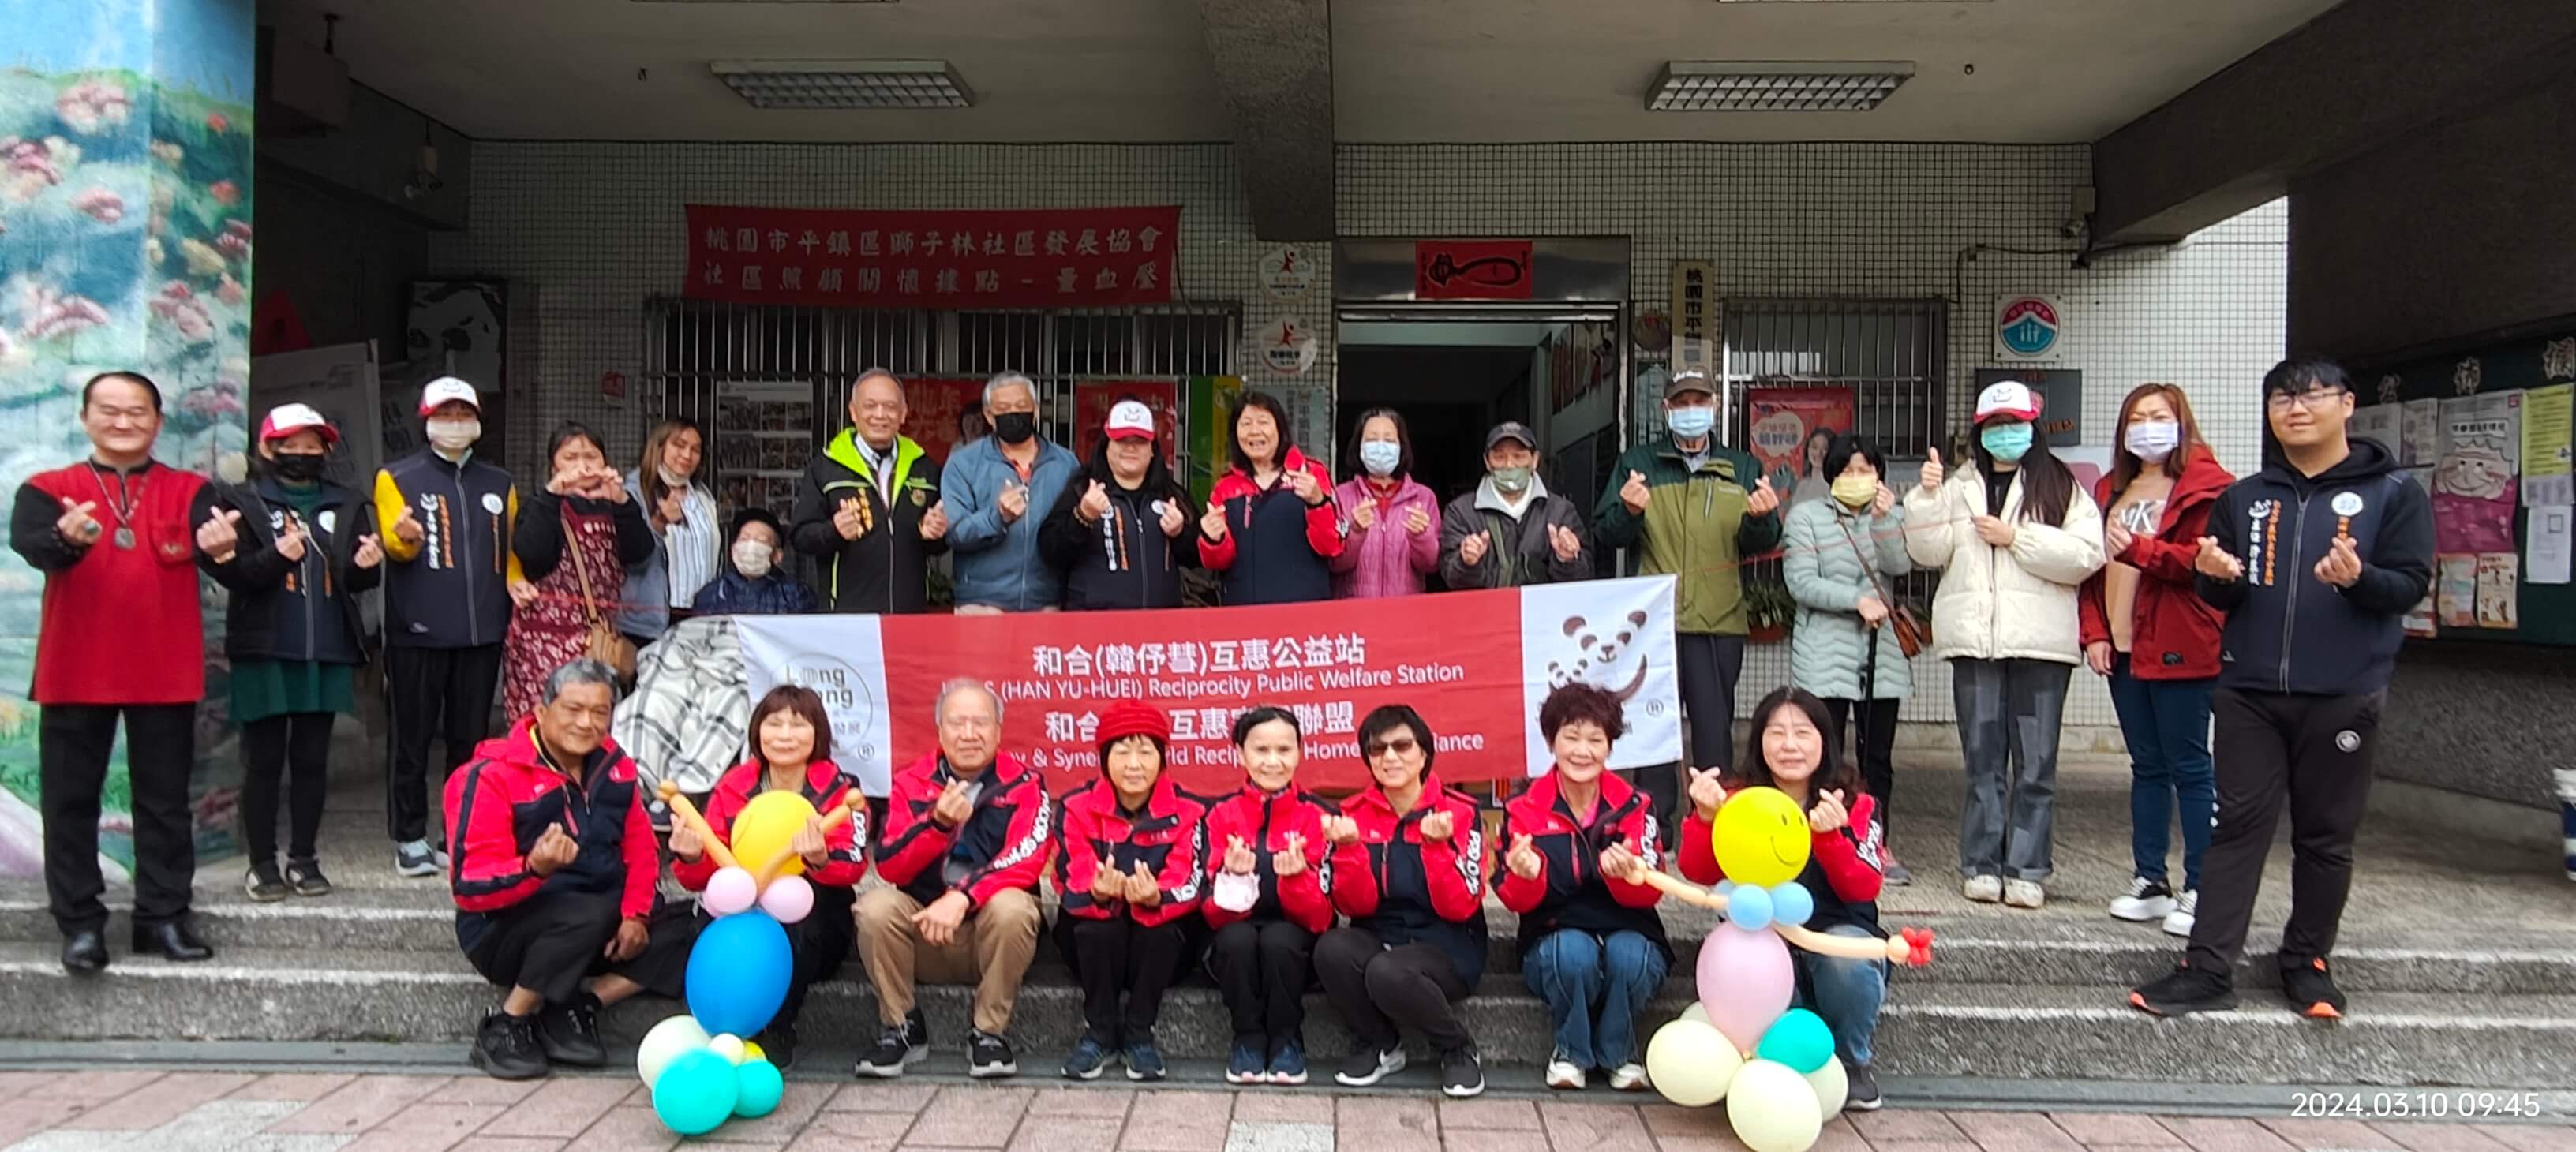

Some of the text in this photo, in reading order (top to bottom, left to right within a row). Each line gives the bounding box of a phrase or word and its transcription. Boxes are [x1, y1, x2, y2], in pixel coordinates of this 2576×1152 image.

[703, 225, 1163, 257] 桃園市平鎮區獅子林社區發展協會
[1002, 680, 1050, 702] (HAN
[1056, 676, 1143, 701] YU-HUEI)
[1149, 671, 1251, 701] Reciprocity
[1257, 669, 1315, 693] Public
[1319, 667, 1391, 689] Welfare
[1397, 661, 1465, 685] Station
[1032, 748, 1048, 768] &
[1303, 740, 1361, 761] Home
